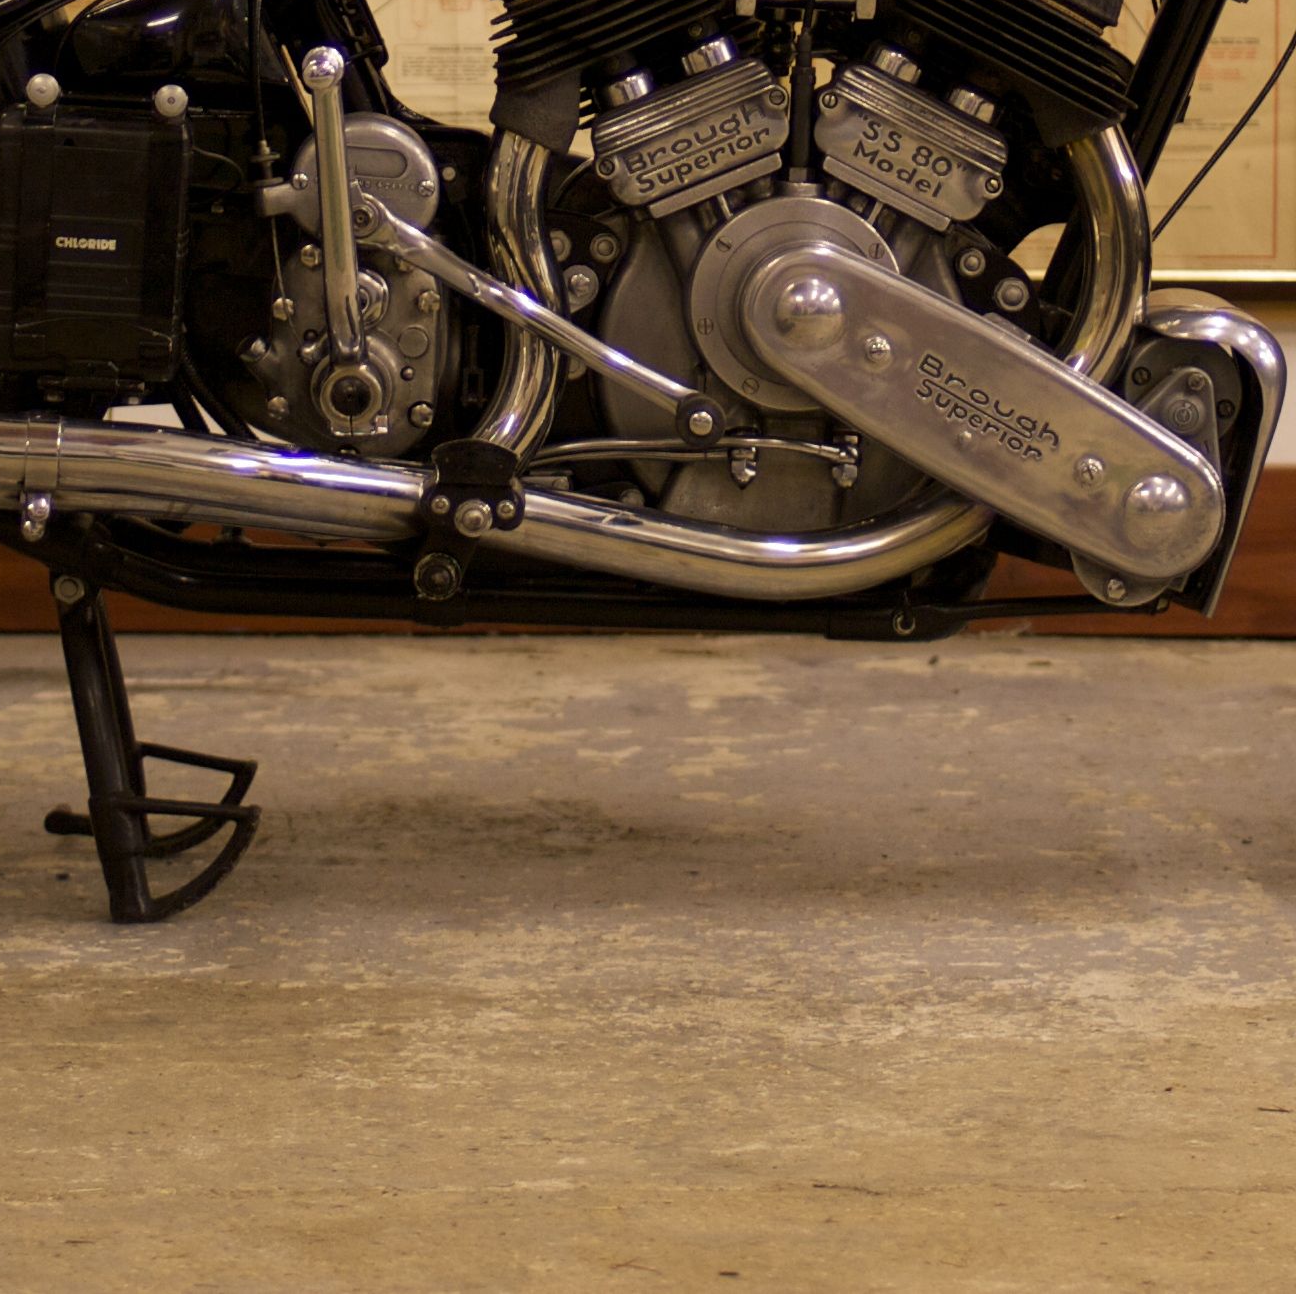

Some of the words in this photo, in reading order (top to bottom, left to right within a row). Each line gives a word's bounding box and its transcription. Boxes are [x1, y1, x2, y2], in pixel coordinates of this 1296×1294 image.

[625, 102, 767, 177] Brough
[636, 127, 771, 193] Superior
[852, 139, 944, 198] Model
[55, 236, 117, 251] CHLORIDE
[916, 377, 1044, 463] Superior
[917, 353, 1061, 449] Brough
